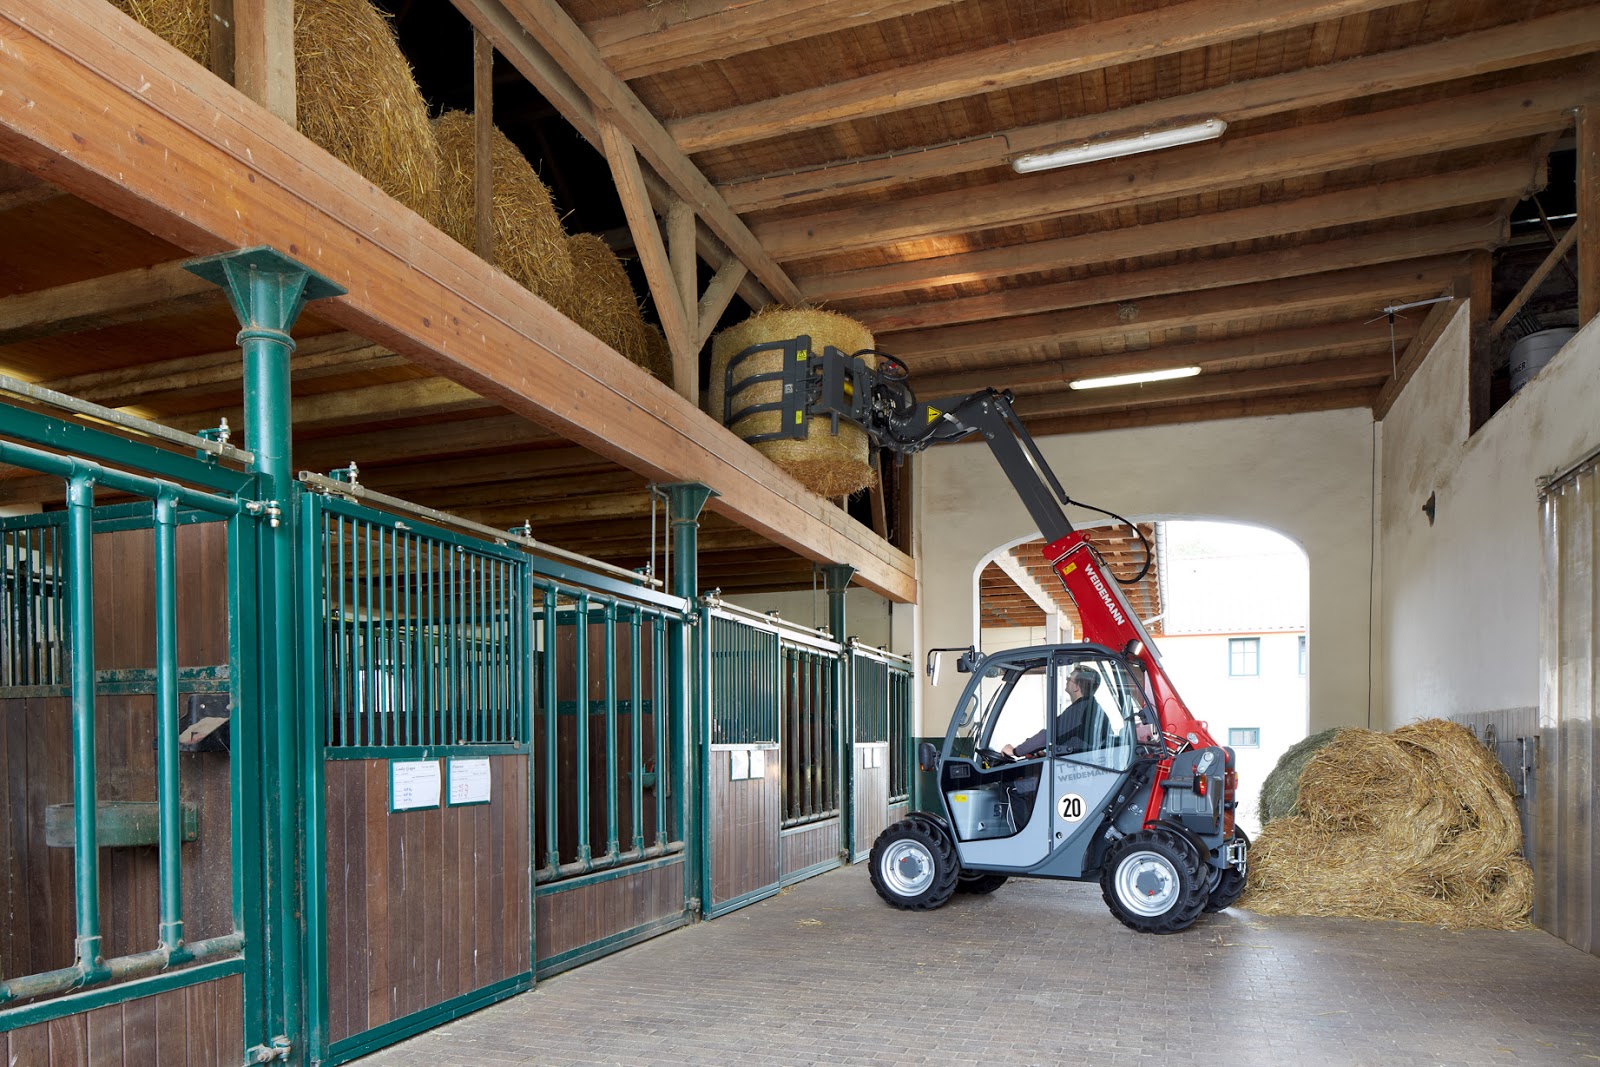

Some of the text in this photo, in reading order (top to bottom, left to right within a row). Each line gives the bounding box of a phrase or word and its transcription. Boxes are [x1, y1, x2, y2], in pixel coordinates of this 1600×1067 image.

[1084, 563, 1125, 626] WEIDEMANN
[1057, 768, 1113, 783] WEIDEMAN
[1063, 798, 1081, 818] 20
